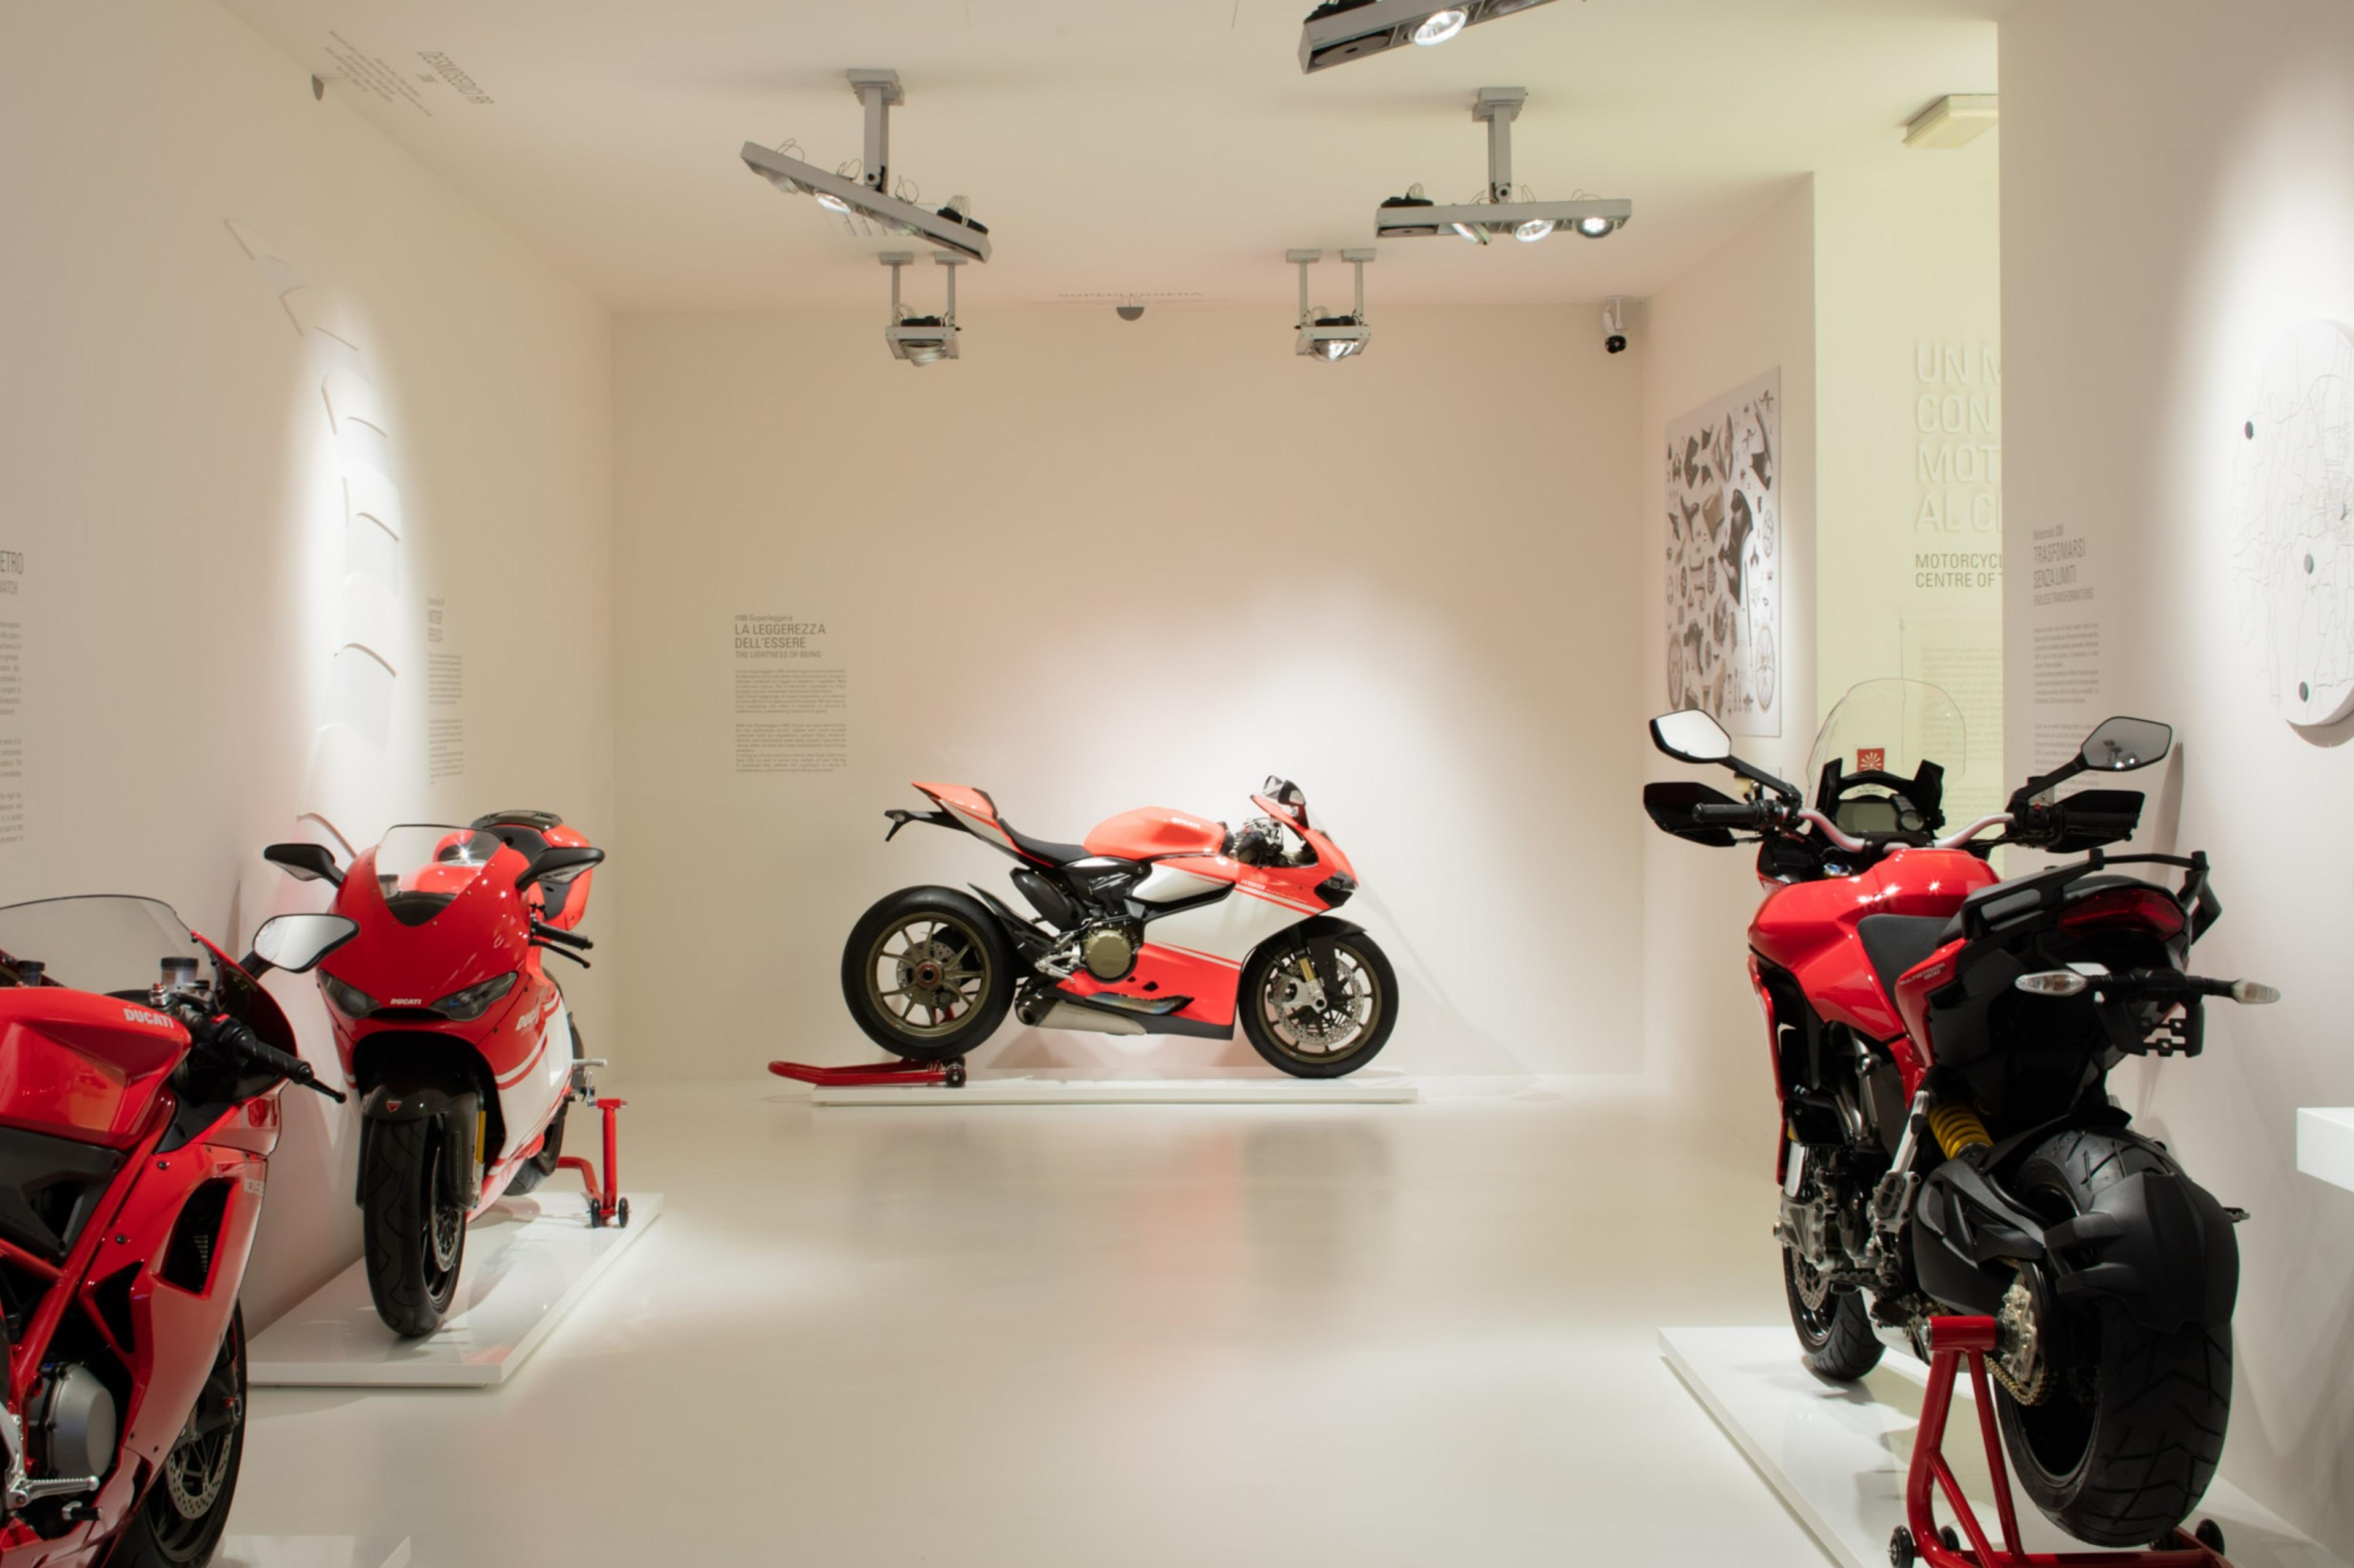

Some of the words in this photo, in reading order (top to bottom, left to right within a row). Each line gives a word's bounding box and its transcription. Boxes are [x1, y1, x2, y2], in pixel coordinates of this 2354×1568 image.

[1914, 346, 1968, 385] UN
[1914, 394, 1992, 434] CON
[1915, 445, 2002, 484] MOT
[1913, 492, 1963, 533] AL
[1915, 572, 1973, 588] CENTRE
[1977, 572, 1995, 588] OF
[749, 614, 793, 622] Superleggera
[734, 623, 750, 635] LA
[753, 623, 826, 635] LEGGEREZZA
[734, 637, 807, 649] DELL'ESSERE
[389, 997, 423, 1006] DUCATI
[122, 1007, 175, 1030] DUCATI
